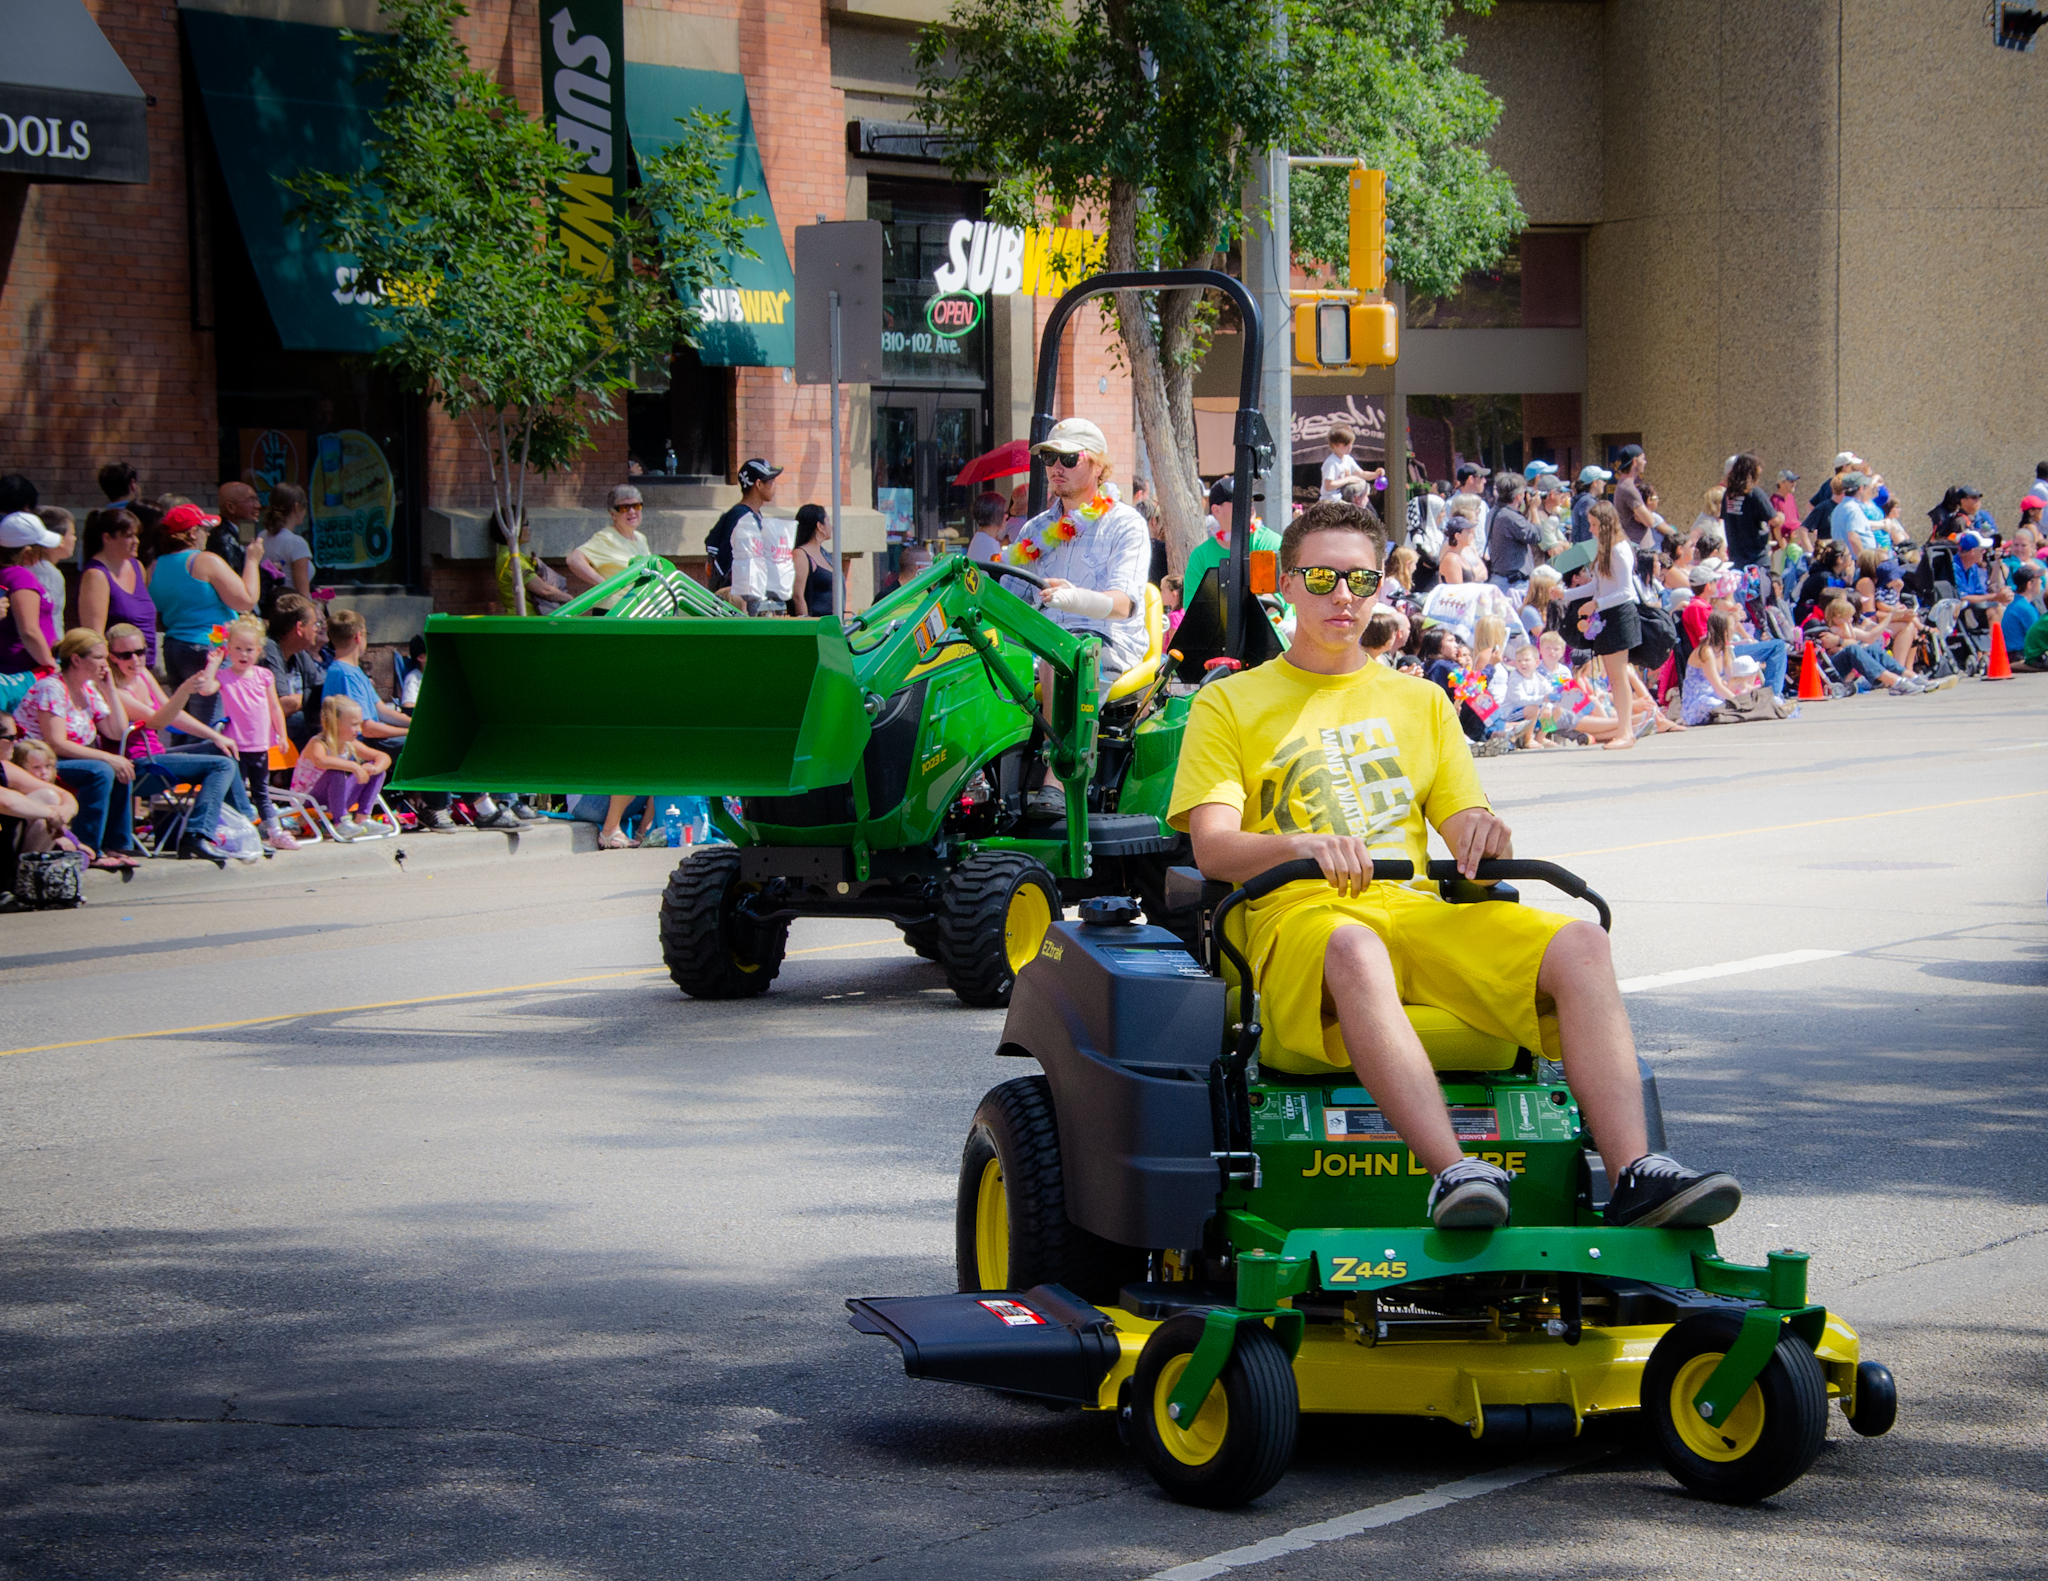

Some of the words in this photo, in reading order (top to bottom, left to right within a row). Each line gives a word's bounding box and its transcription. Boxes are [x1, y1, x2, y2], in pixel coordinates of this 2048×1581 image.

[0, 113, 91, 160] OOLS
[699, 288, 791, 325] SUBWAY
[933, 300, 974, 326] OPEN
[935, 335, 961, 354] Ave.
[316, 519, 353, 533] SUPER
[318, 534, 353, 549] SOUP
[921, 754, 941, 777] 1023
[1321, 728, 1347, 775] WIND
[1335, 786, 1370, 838] WATER
[1041, 939, 1064, 962] EZtrak
[1301, 1149, 1399, 1177] JOHN
[1407, 1149, 1526, 1176] DRE
[1329, 1256, 1408, 1283] Z445
